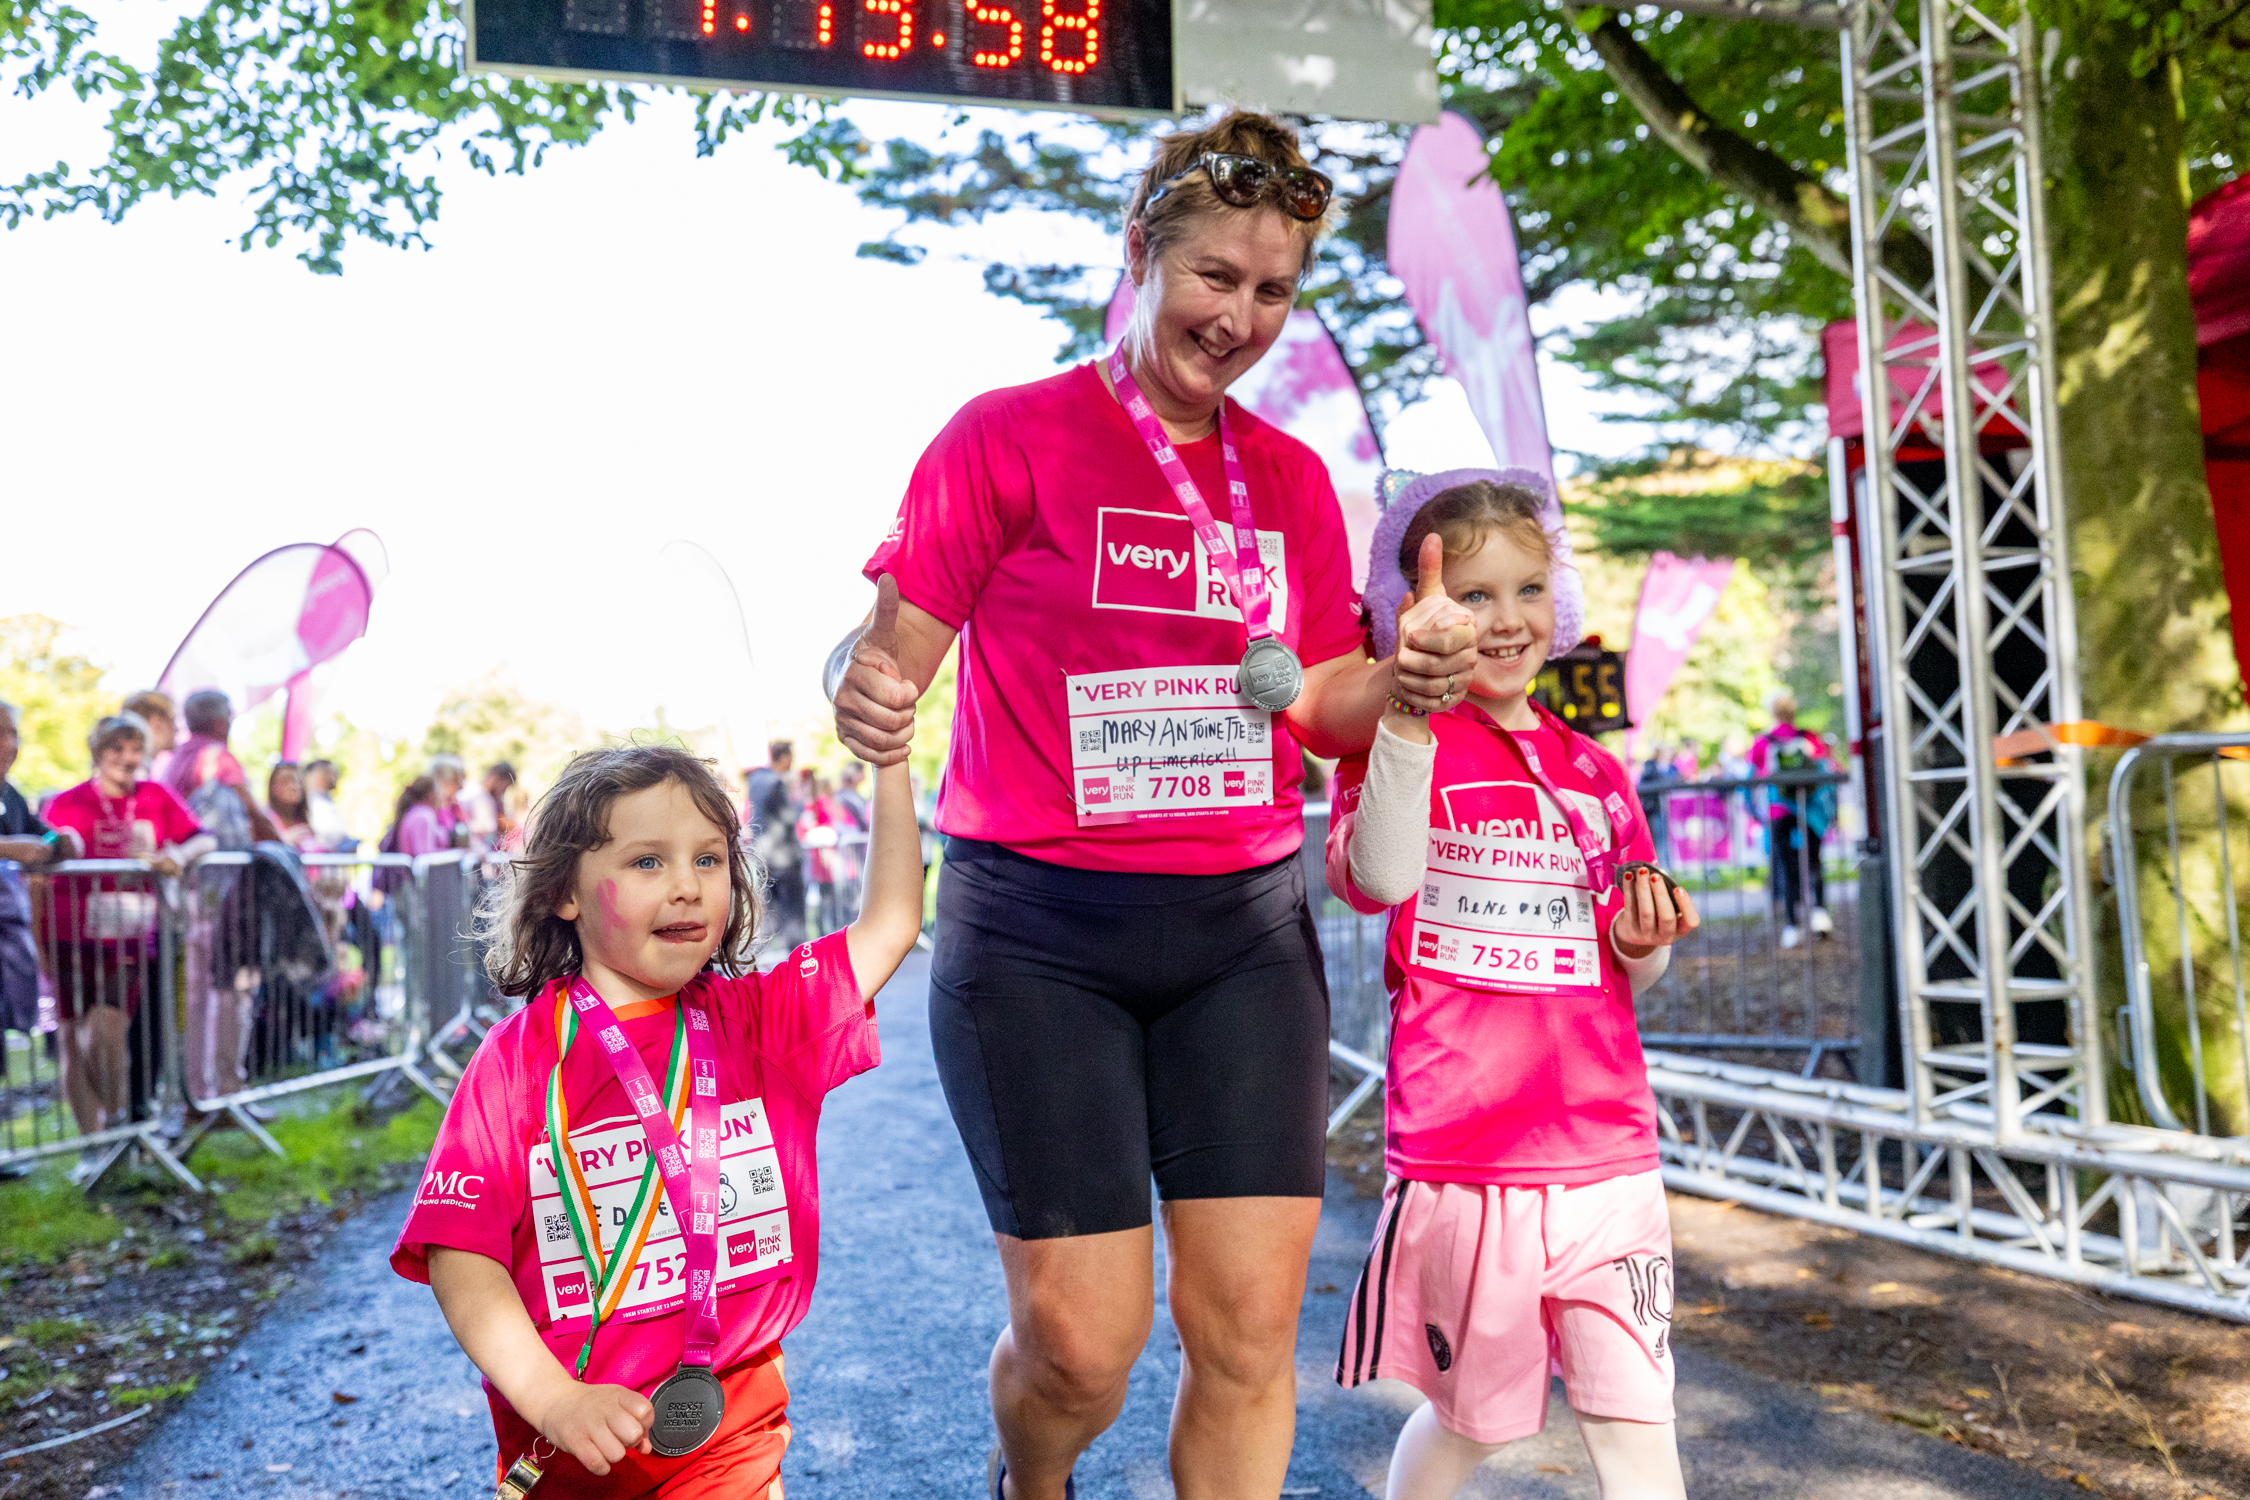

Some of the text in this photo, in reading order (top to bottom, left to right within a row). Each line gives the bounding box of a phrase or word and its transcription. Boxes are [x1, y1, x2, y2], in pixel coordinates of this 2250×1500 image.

[1107, 541, 1190, 580] very
[1084, 677, 1241, 702] VERY PINK RU
[1102, 718, 1156, 754] MARY
[1084, 784, 1136, 796] very PINK
[1148, 774, 1211, 799] 7708
[1225, 779, 1266, 790] very PINK
[1247, 787, 1264, 795] RUN
[1113, 792, 1134, 801] RUN
[1436, 841, 1581, 875] VERY PINK RUN
[1419, 939, 1438, 952] very
[1440, 944, 1459, 955] PINK
[1440, 952, 1457, 962] RUN
[1472, 944, 1539, 971] 7526
[1555, 956, 1575, 968] very
[701, 1061, 709, 1078] very
[634, 1079, 647, 1096] very
[545, 1143, 618, 1179] VRY
[719, 1115, 753, 1142] UN
[440, 1198, 477, 1211] MEDICINE
[700, 1194, 708, 1232] very PINK
[729, 1233, 782, 1255] very PINK
[759, 1243, 780, 1257] RUN
[633, 1252, 688, 1291] 752
[556, 1282, 585, 1296] very
[622, 1310, 637, 1319] 10KM
[636, 1306, 656, 1316] STARTS
[717, 1283, 736, 1293] 12:45PM
[663, 1419, 701, 1428] IRELAND
[666, 1411, 703, 1420] CANCER
